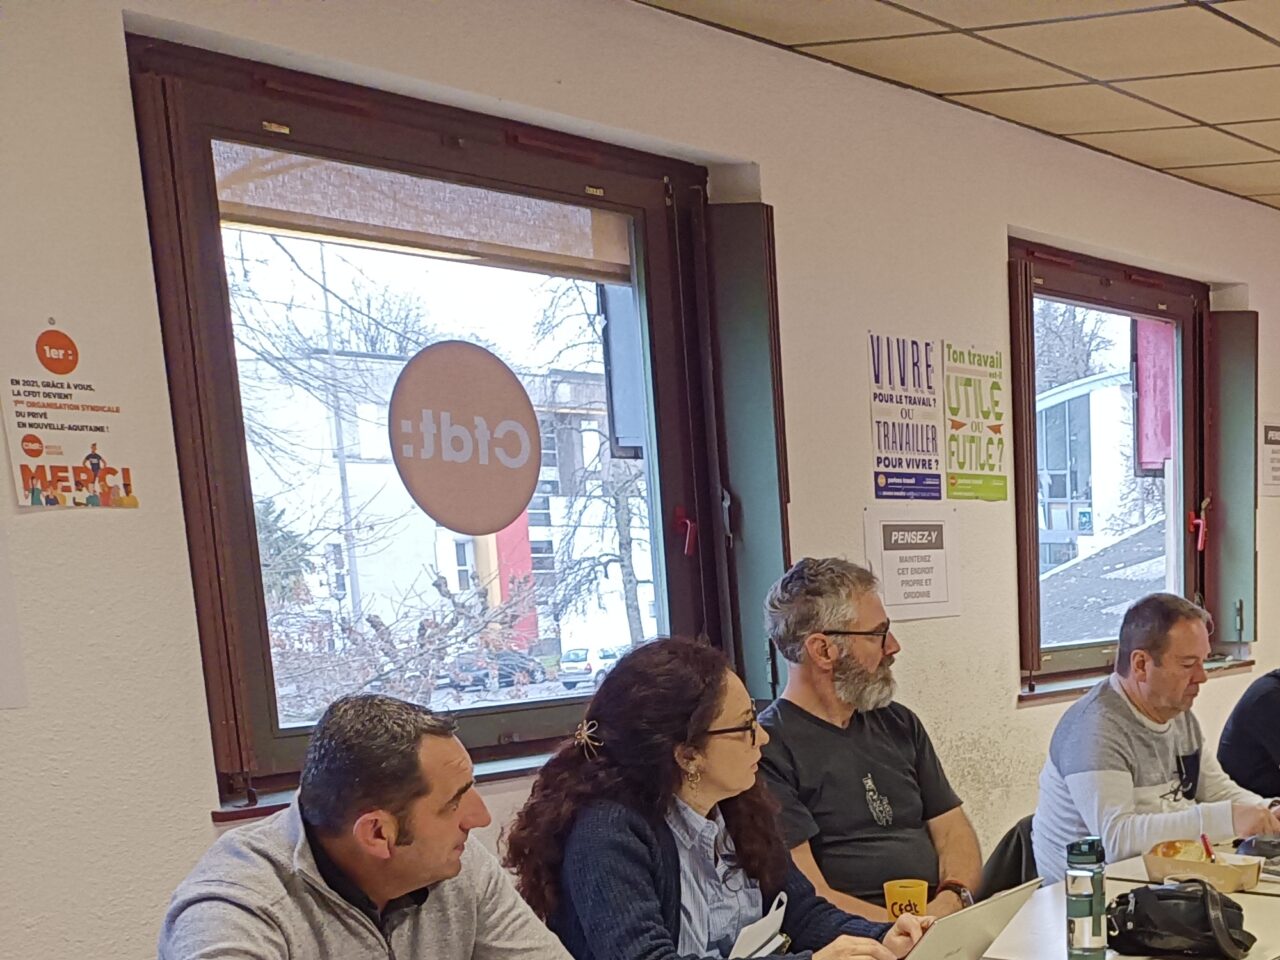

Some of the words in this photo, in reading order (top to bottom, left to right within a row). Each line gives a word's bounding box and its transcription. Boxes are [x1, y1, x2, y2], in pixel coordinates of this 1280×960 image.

[870, 334, 935, 391] VIVRE
[946, 343, 965, 364] Ton
[968, 349, 1002, 369] travail
[11, 378, 20, 386] EN
[41, 380, 65, 389] GRÂCE
[12, 389, 21, 397] LA
[23, 390, 41, 398] CFDT
[42, 391, 73, 400] DEVIENT
[873, 392, 894, 403] POUR
[895, 394, 903, 405] LE
[904, 395, 932, 407] TRAVAIL
[946, 374, 1003, 421] UTILE
[26, 401, 80, 411] ORGANISATION
[81, 404, 120, 414] SYNDICALE
[900, 408, 914, 420] OU
[15, 410, 26, 418] DU
[27, 411, 48, 420] PRIVÉ
[970, 421, 984, 433] OU
[875, 420, 938, 453] TRAVAILLER
[876, 456, 903, 468] POUR
[905, 457, 933, 470] VIVRE
[891, 530, 938, 544] PENSEZ-Y
[897, 567, 909, 576] CET
